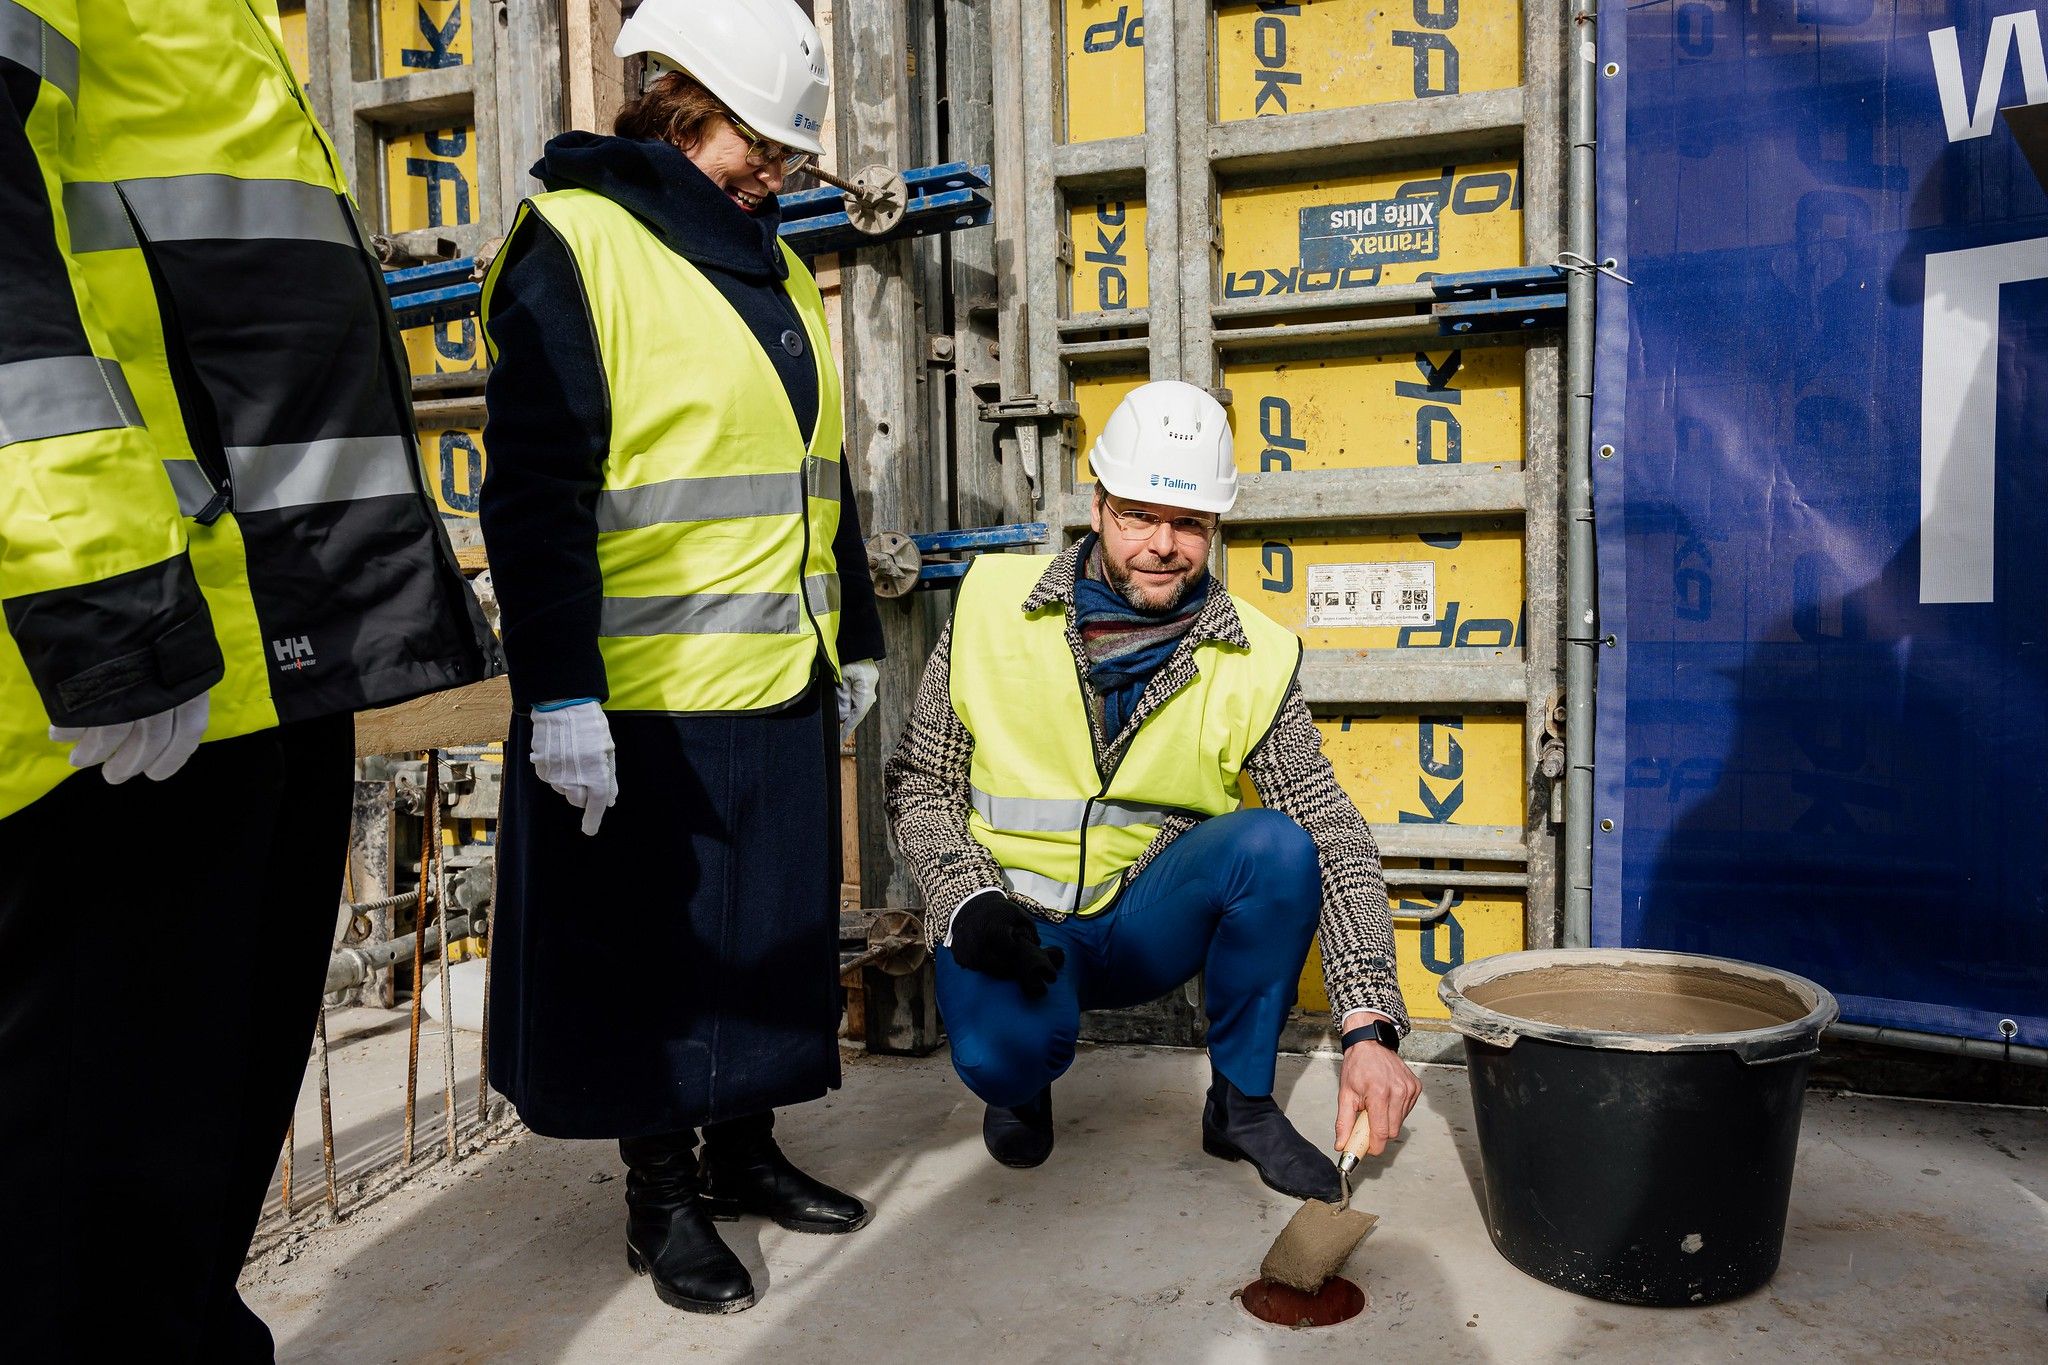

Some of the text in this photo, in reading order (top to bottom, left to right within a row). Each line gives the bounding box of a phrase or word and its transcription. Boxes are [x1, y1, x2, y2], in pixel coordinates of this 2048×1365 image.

[1330, 202, 1434, 231] Xlife plus
[1350, 230, 1434, 256] Framax
[1163, 477, 1197, 491] Tallinn
[272, 635, 314, 661] HH
